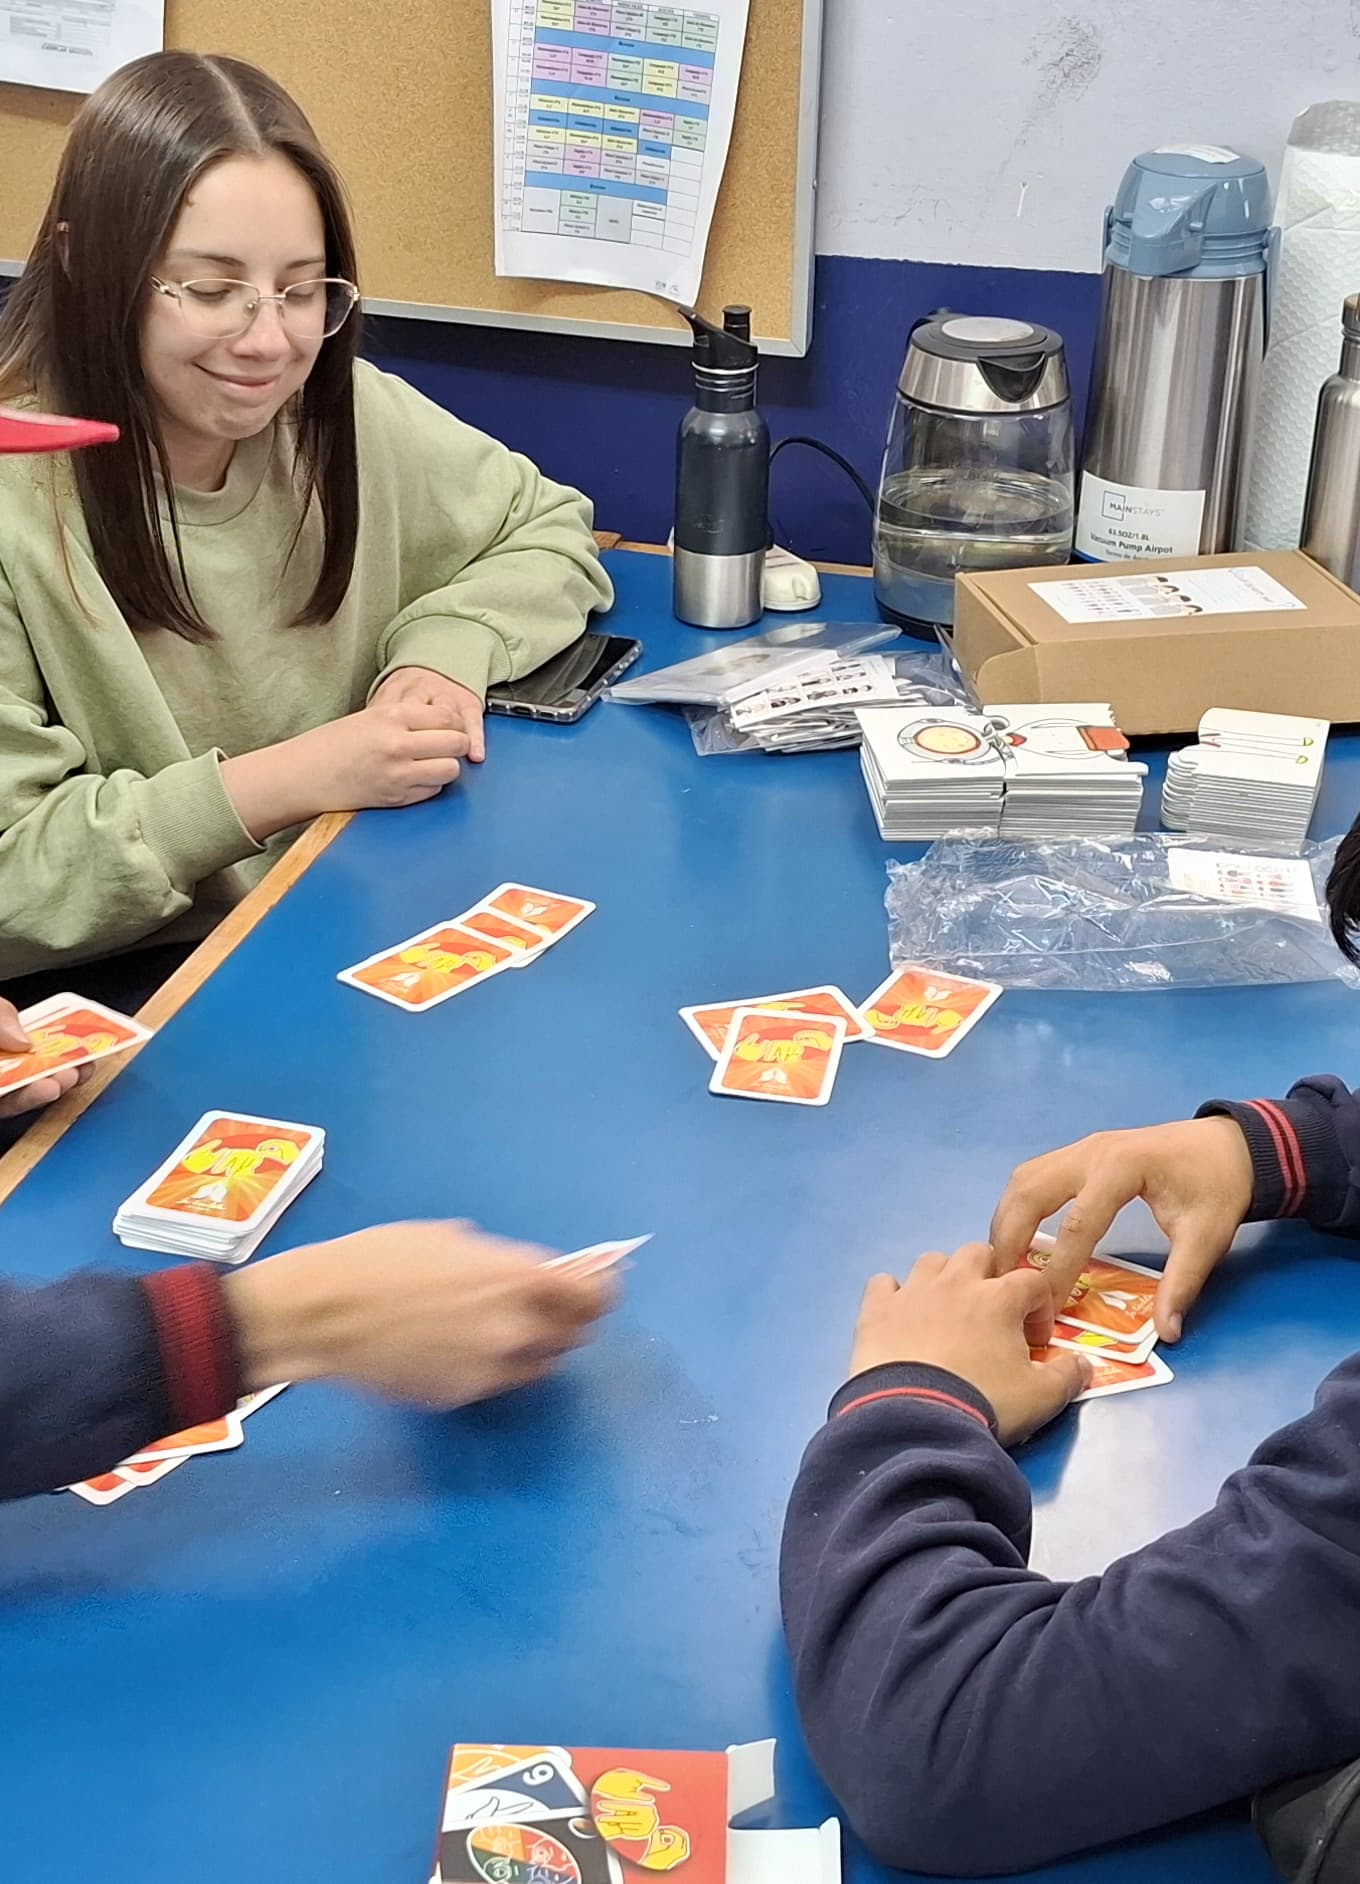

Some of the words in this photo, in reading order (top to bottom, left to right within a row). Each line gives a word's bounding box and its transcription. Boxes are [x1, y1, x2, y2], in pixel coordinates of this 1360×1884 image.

[1090, 533, 1117, 547] Vacuum
[1118, 541, 1143, 553] Pump
[1145, 542, 1174, 555] Airpot
